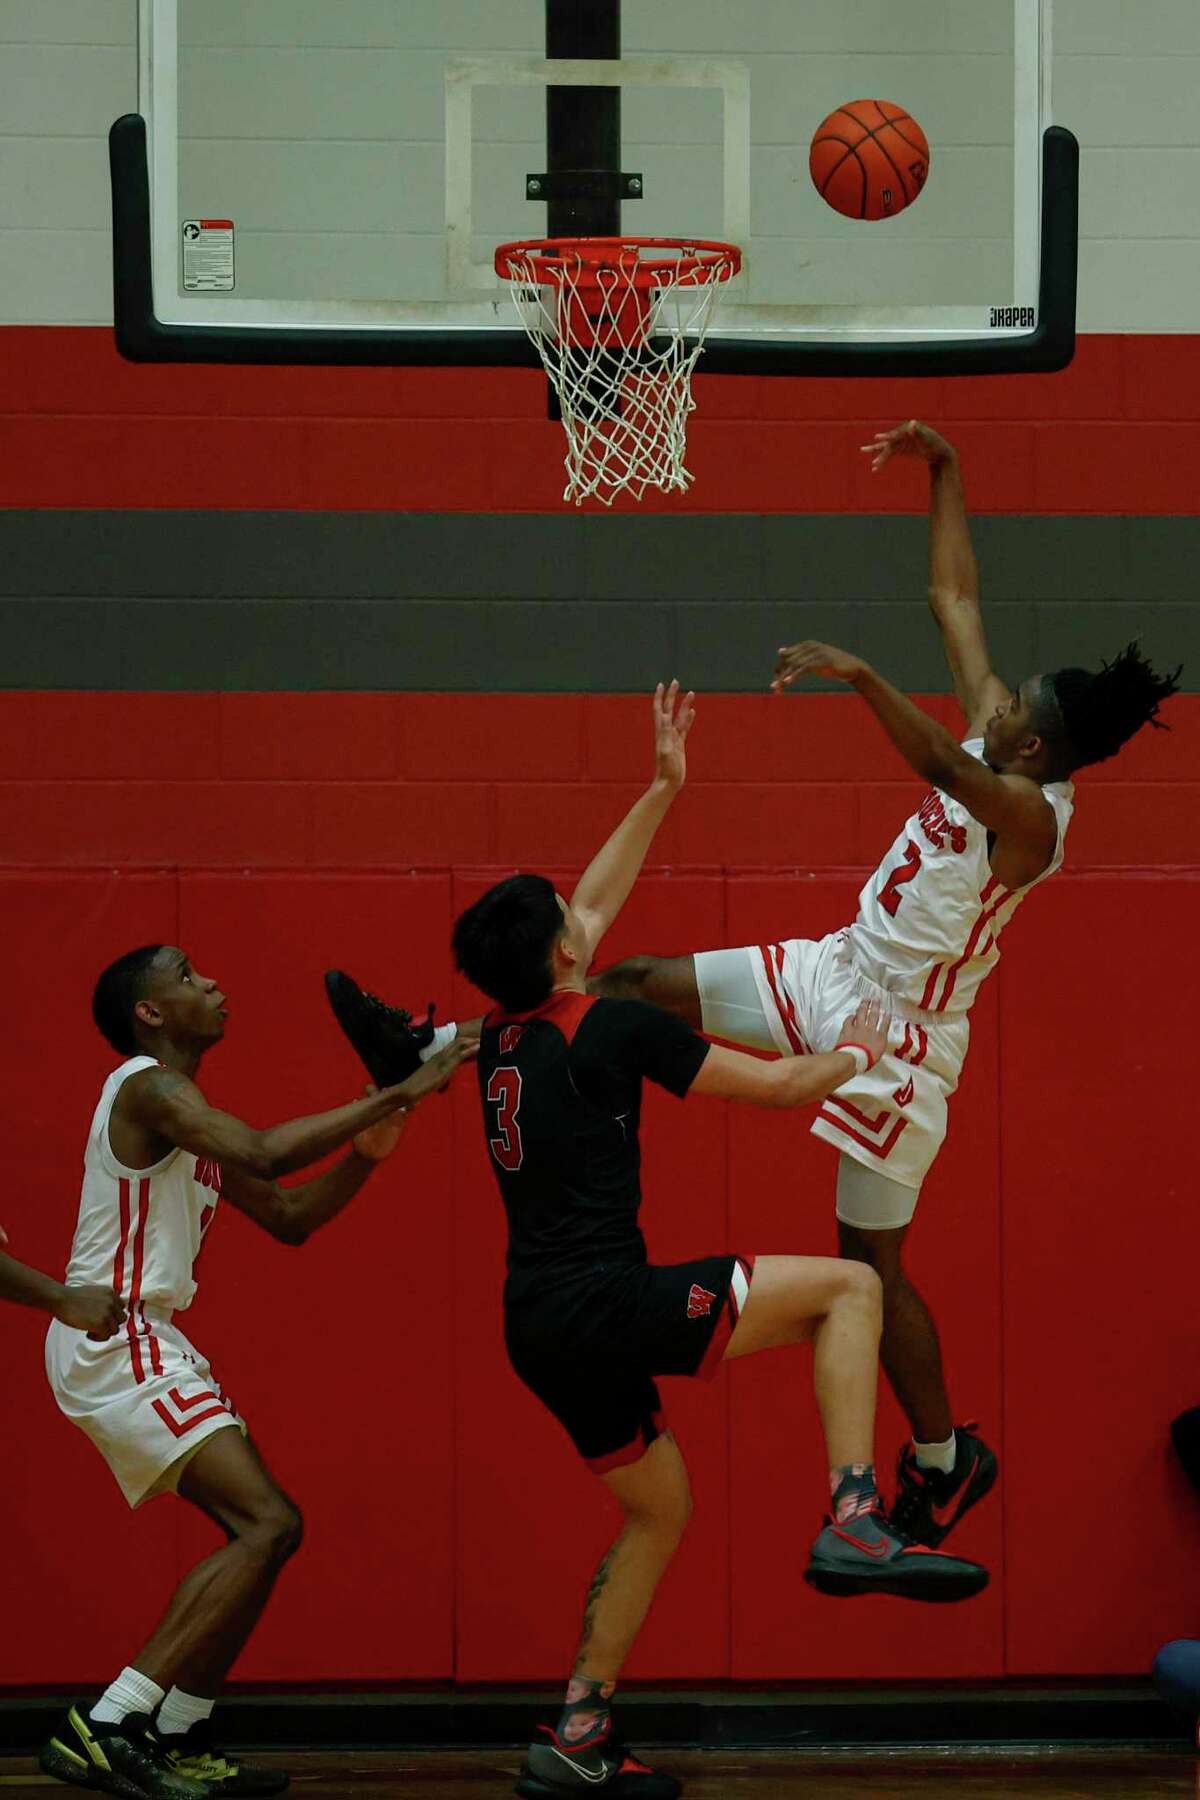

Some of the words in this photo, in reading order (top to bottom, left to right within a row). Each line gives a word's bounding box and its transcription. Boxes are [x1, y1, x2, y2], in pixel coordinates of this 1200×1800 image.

[876, 839, 921, 918] 2
[487, 1066, 523, 1170] 3
[687, 1283, 717, 1318] W
